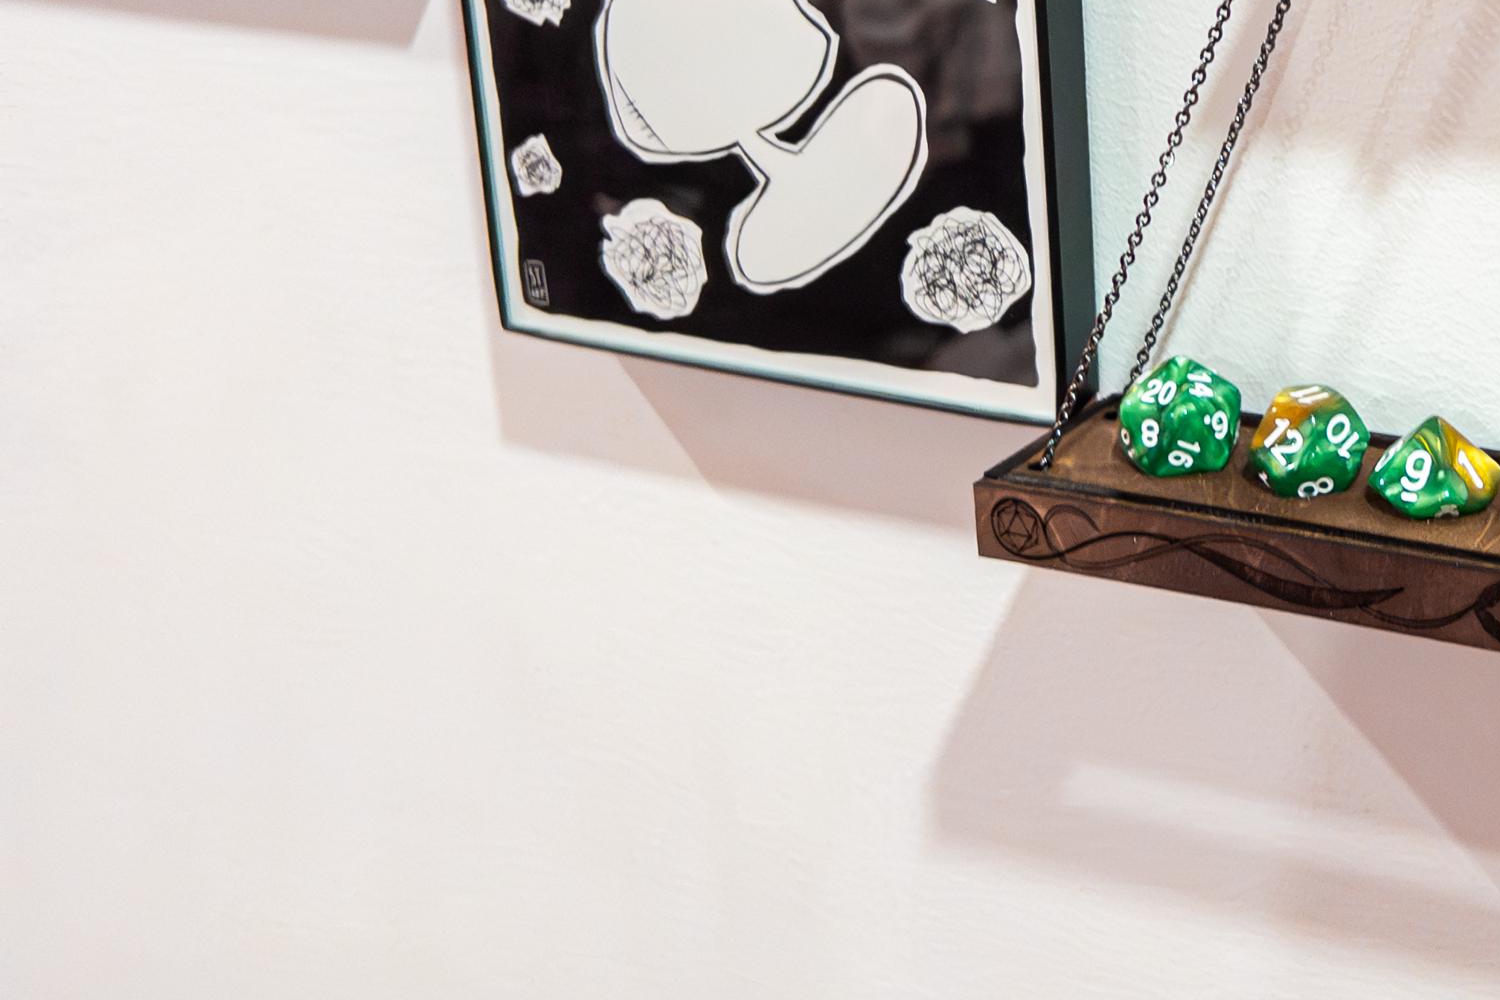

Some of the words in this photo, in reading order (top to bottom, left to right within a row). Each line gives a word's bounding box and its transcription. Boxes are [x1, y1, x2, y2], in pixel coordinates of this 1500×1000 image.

[1141, 379, 1177, 405] 20
[1141, 418, 1160, 448] 8
[1458, 449, 1484, 489] 1
